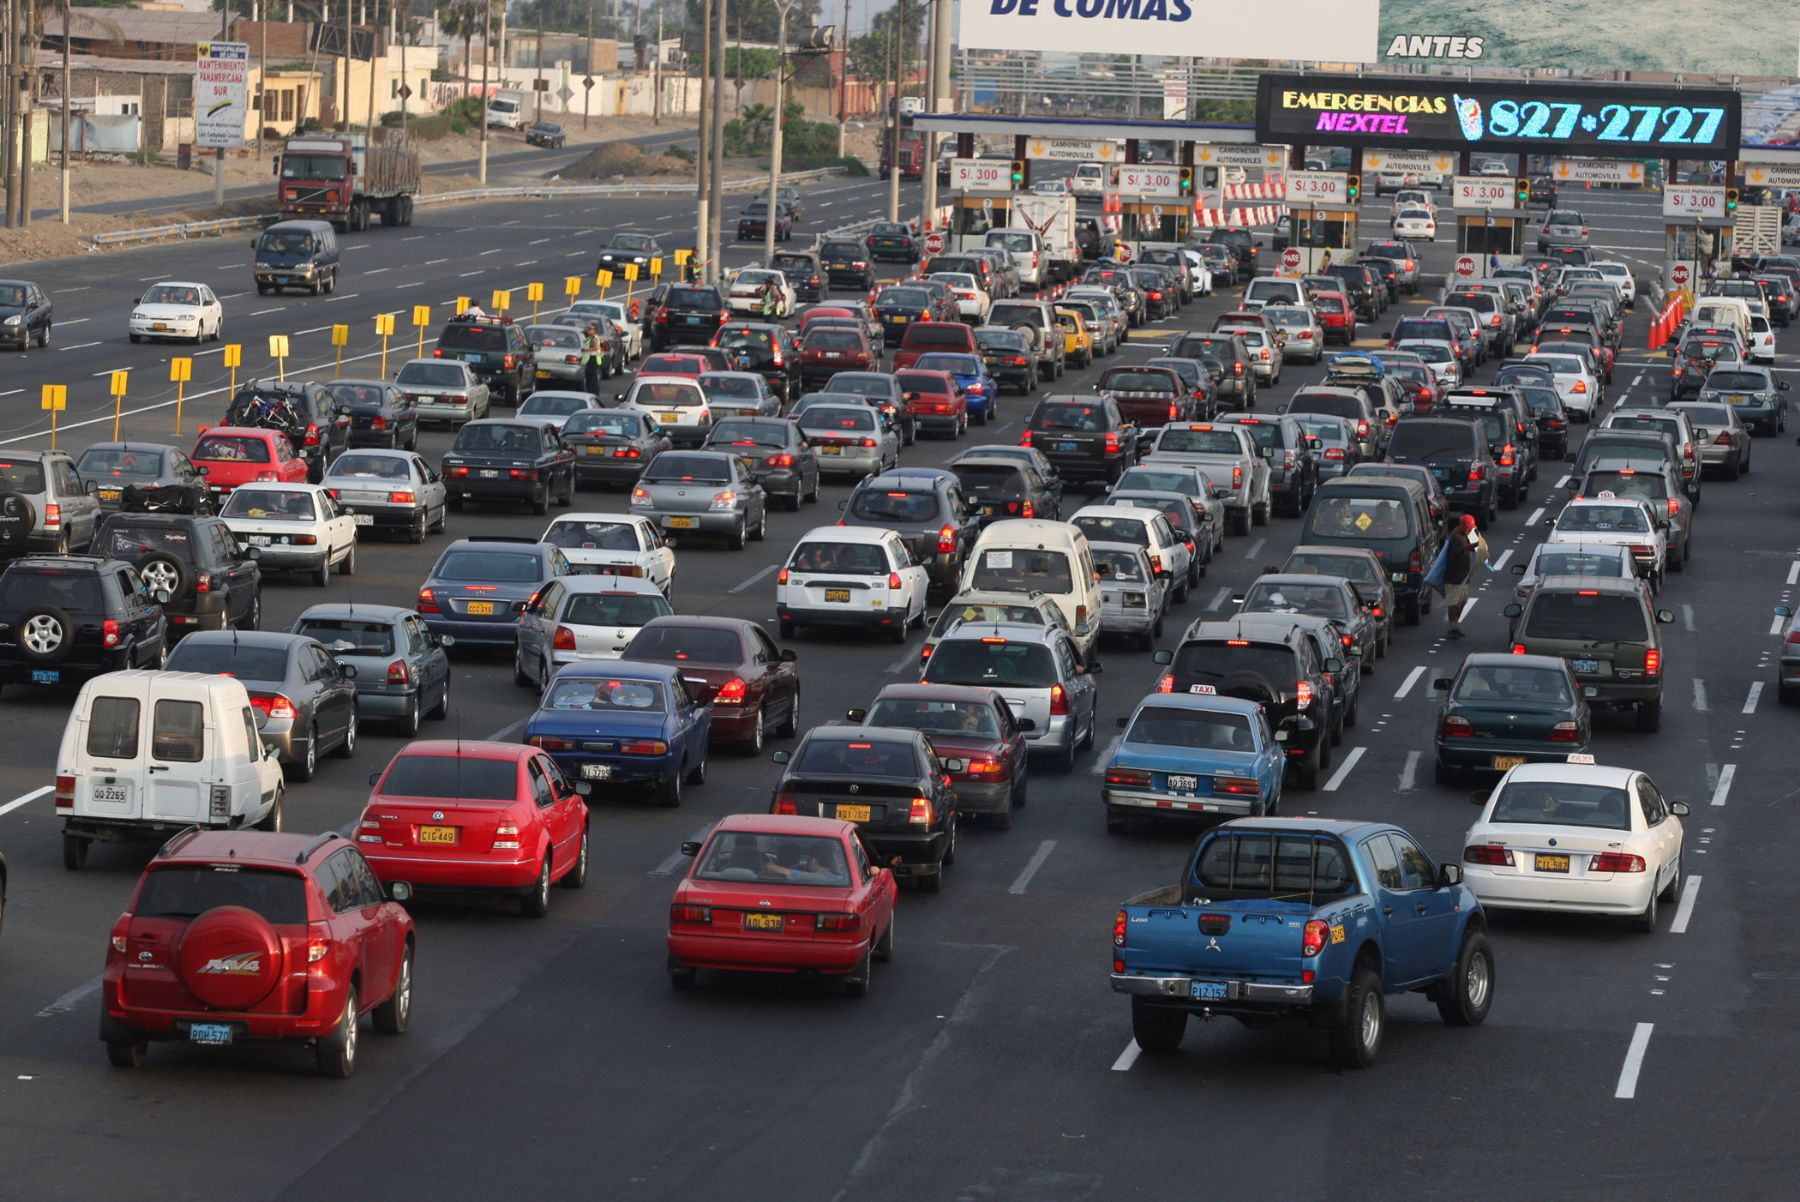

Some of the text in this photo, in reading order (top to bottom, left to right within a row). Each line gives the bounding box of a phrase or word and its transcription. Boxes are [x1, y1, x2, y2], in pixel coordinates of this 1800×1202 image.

[990, 0, 1191, 22] DE COMAS
[1386, 34, 1484, 59] ANTES
[199, 60, 245, 71] MANTENIMIENTO
[200, 71, 242, 83] PANAMERICANA
[213, 86, 228, 96] SUR
[1283, 91, 1447, 114] EMERGENCIAS
[1315, 111, 1409, 134] NEXTEL
[1051, 140, 1092, 149] CAMIONETAS
[1049, 151, 1094, 159] AUTOMOVILES
[1219, 147, 1260, 155] CAMIONETAS
[1388, 152, 1429, 160] CAMIONETAS
[1216, 156, 1262, 164] AUTOMOVILES
[1577, 161, 1618, 169] CAMIONETAS
[1385, 163, 1431, 171] AUTOMOVILES
[976, 169, 998, 180] 300
[1574, 171, 1621, 179] AUTOMOVILES
[1145, 175, 1170, 186] 3.00
[1311, 181, 1336, 192] 3.00
[1479, 187, 1504, 198] 3.00
[1691, 195, 1715, 207] 3.00
[926, 240, 944, 249] PARE
[1283, 254, 1301, 263] PARE
[1457, 262, 1475, 271] PARE
[1671, 270, 1689, 280] PARE
[1193, 686, 1213, 694] TAXI
